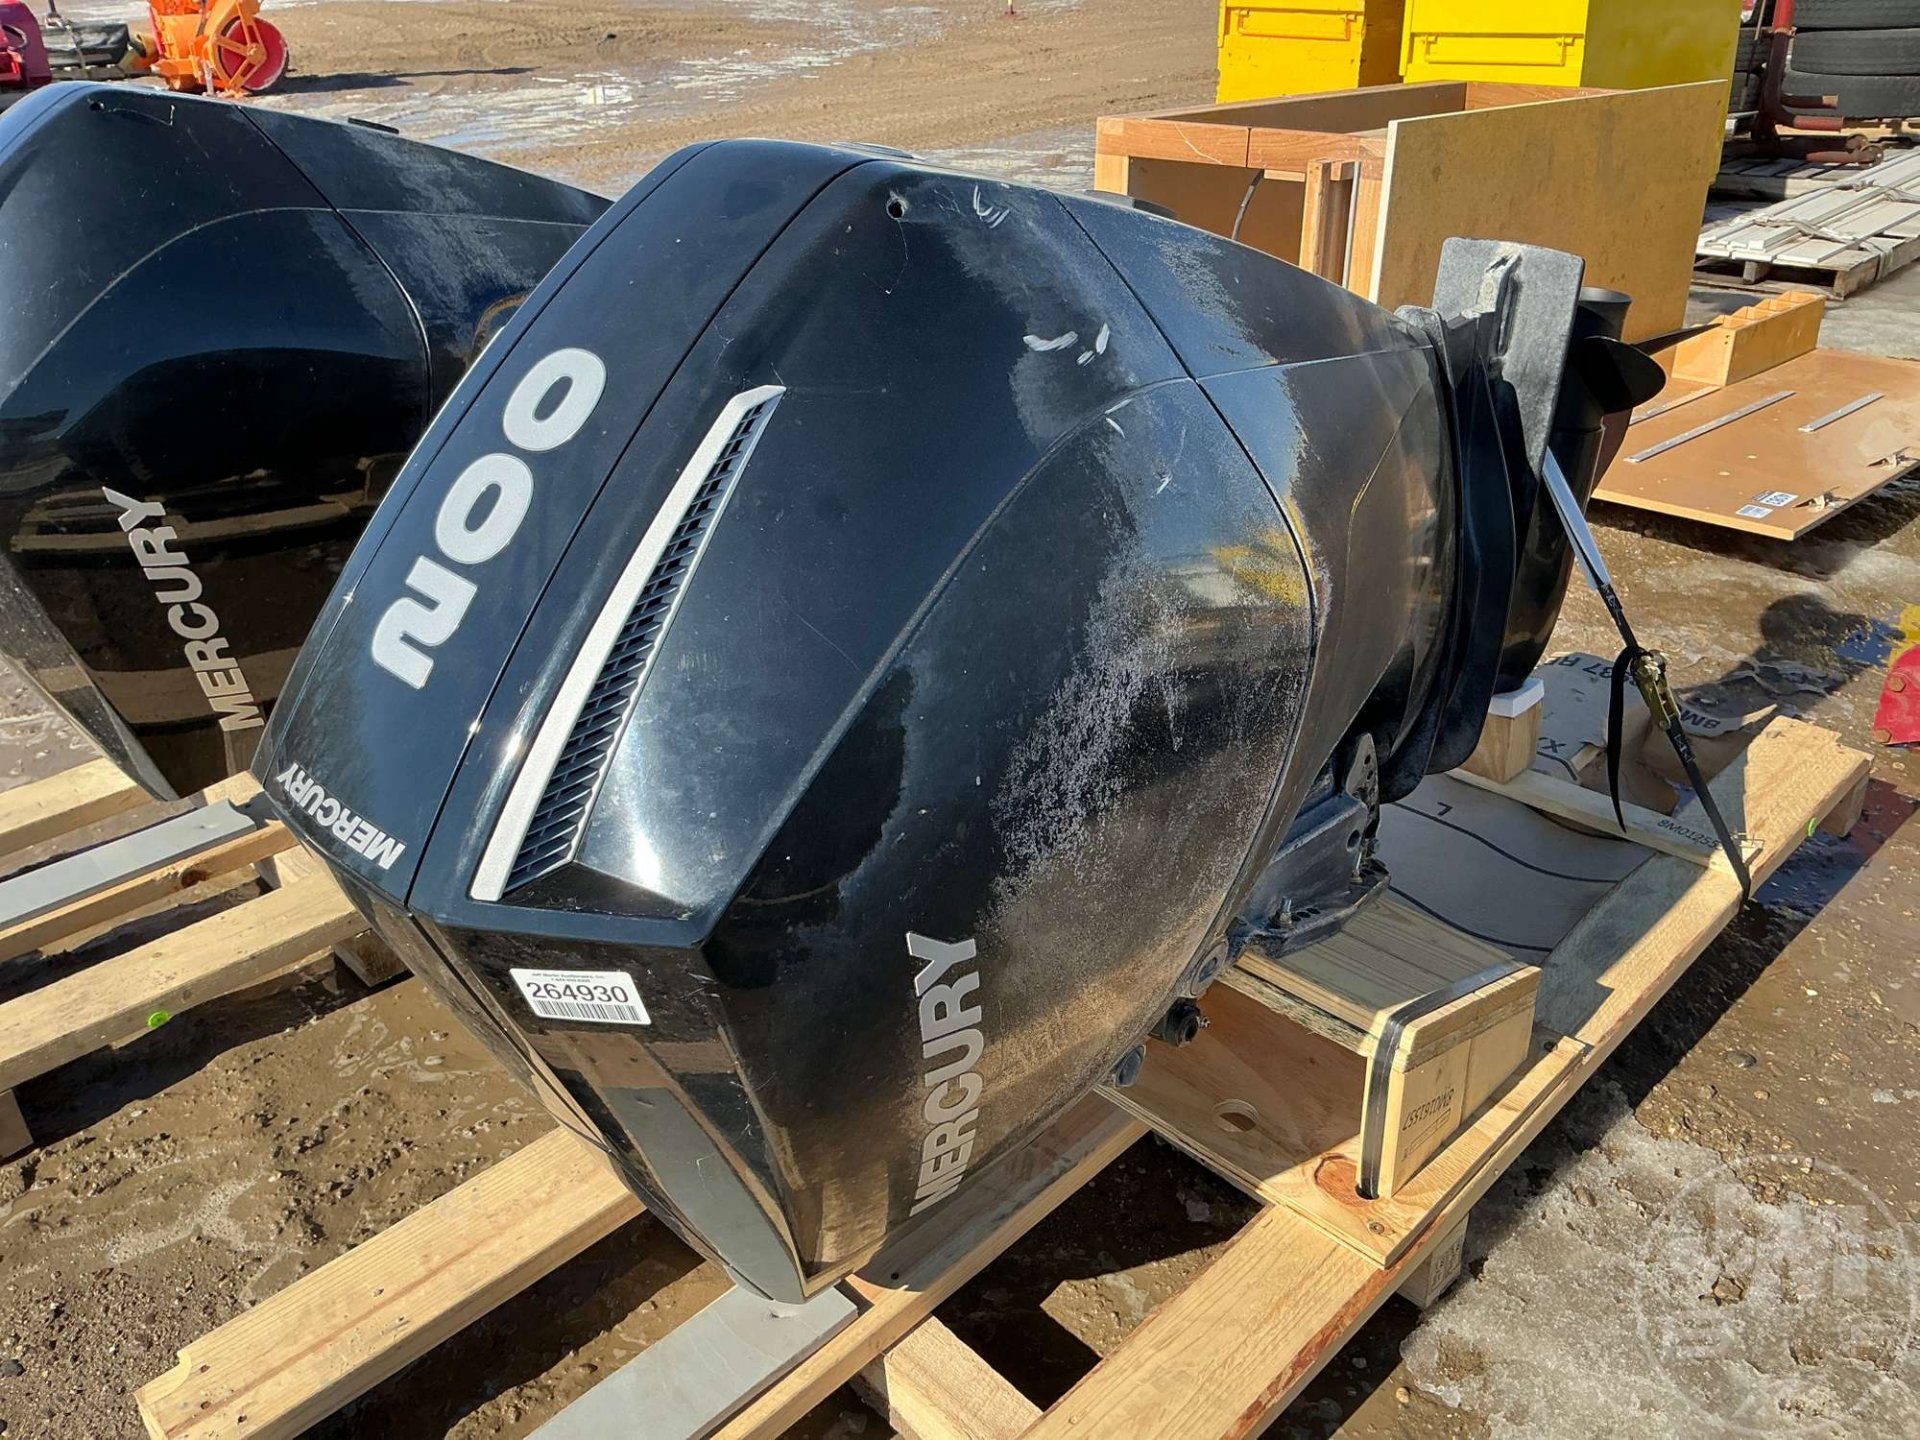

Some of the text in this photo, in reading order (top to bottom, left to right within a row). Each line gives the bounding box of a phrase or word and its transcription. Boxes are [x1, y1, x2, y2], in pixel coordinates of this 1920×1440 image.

[371, 347, 607, 690] 200
[102, 486, 265, 732] MERCURY
[276, 762, 407, 870] MERCURY
[1657, 819, 1721, 849] 8M01255
[526, 982, 629, 1003] 264930
[906, 932, 985, 1217] MERCURY
